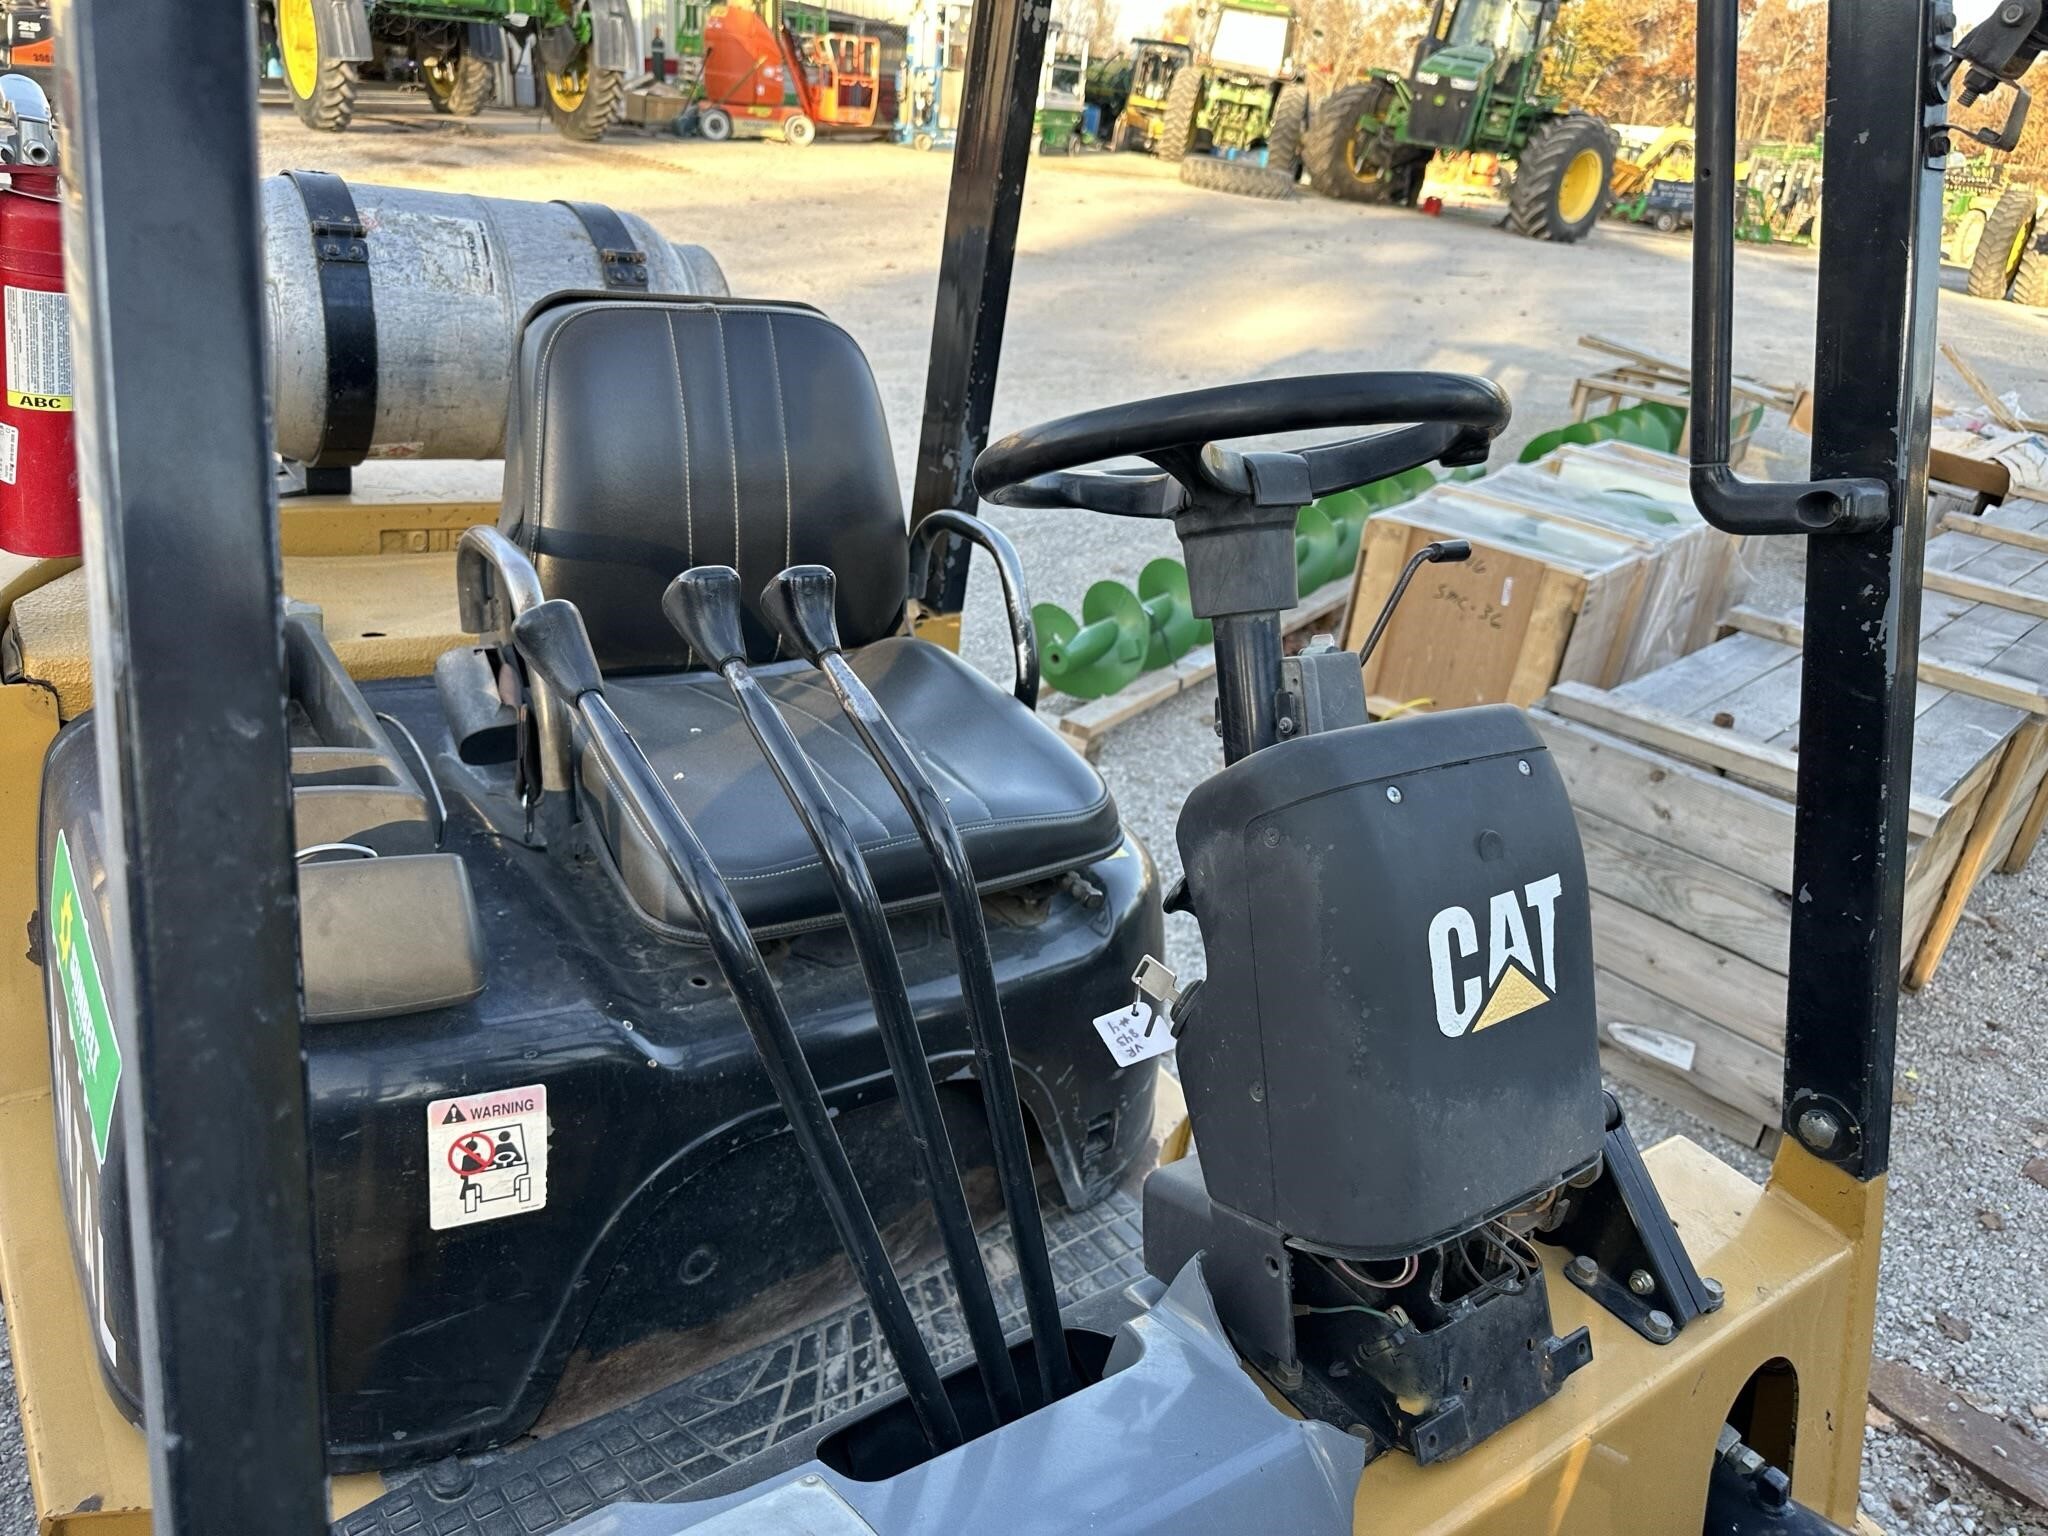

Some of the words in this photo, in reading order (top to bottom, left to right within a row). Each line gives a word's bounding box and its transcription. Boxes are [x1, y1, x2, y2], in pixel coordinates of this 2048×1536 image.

[20, 395, 62, 409] ABC
[1428, 873, 1562, 1037] CAT
[1126, 1044, 1144, 1058] VR
[470, 1099, 534, 1120] WARNING
